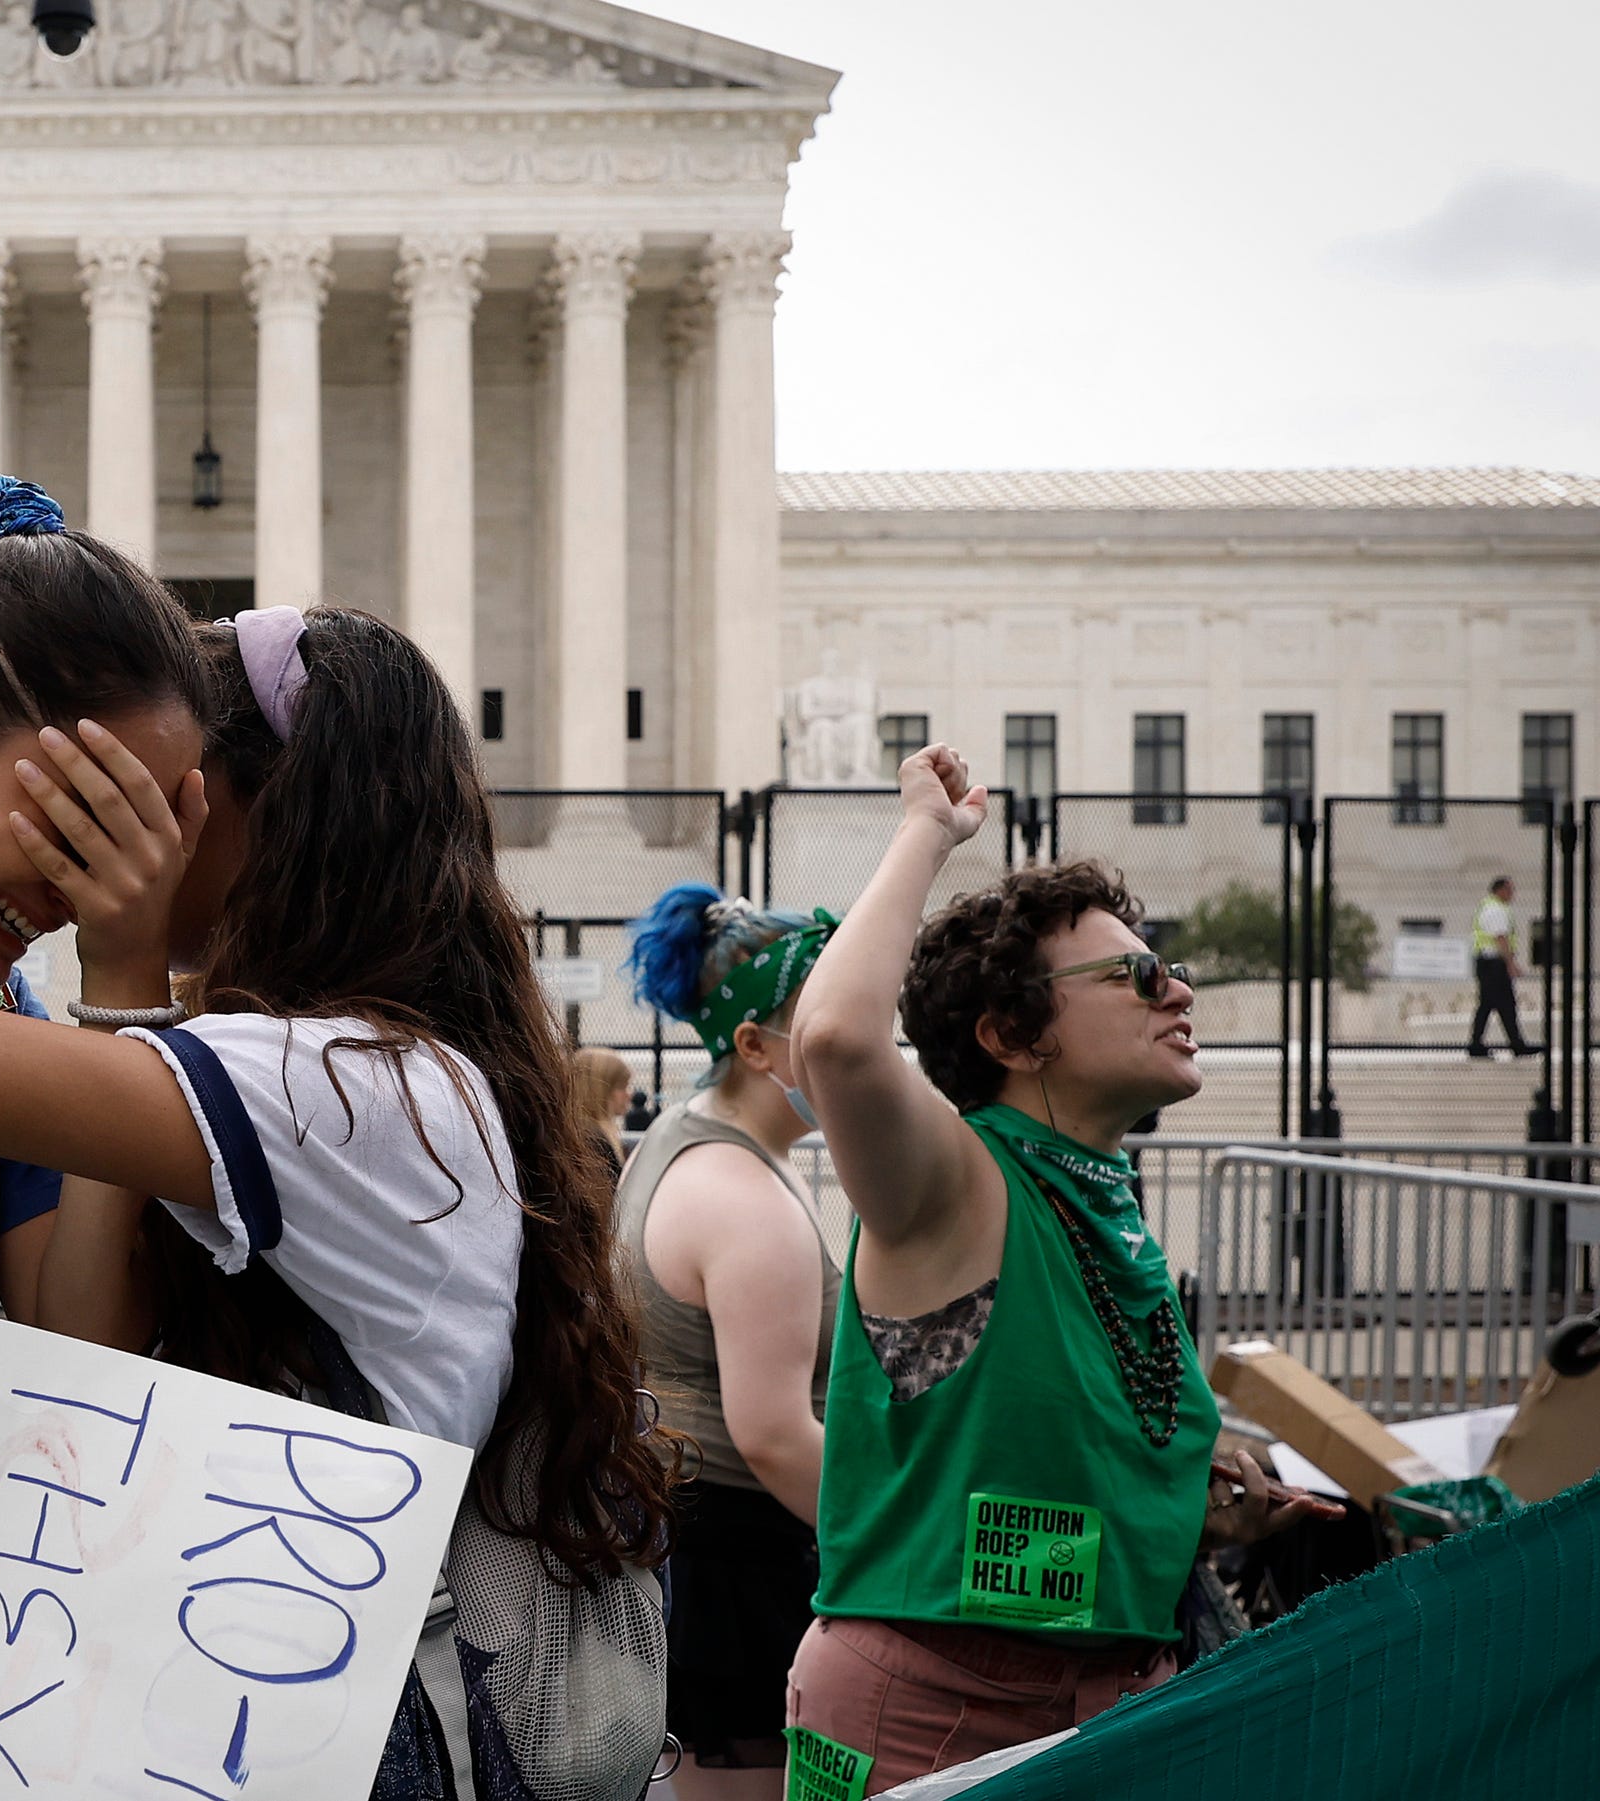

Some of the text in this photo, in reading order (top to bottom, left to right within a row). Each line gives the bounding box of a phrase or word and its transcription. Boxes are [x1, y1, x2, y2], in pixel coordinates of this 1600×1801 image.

[977, 1501, 1085, 1537] OVERTURN
[974, 1529, 1030, 1558] ROE?
[971, 1560, 1084, 1603] HELL NO!
[138, 1422, 423, 1801] PRO-
[795, 1730, 859, 1783] FORCED
